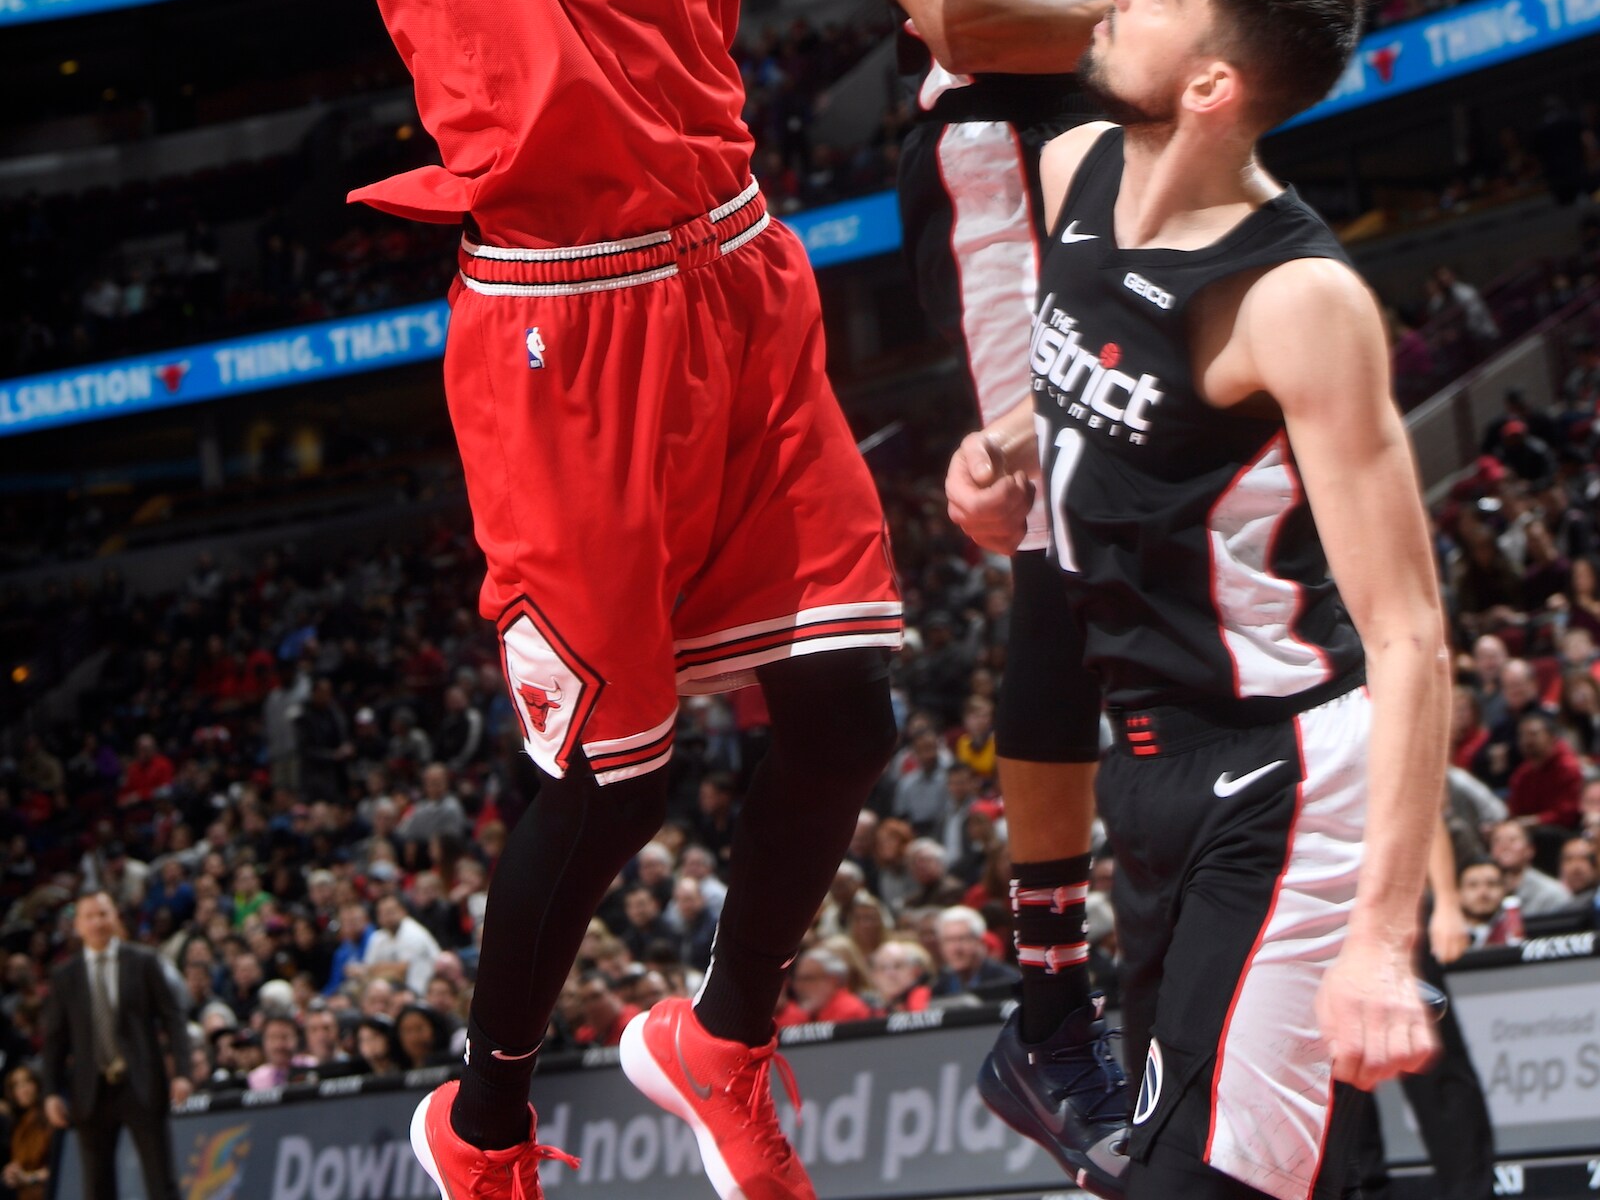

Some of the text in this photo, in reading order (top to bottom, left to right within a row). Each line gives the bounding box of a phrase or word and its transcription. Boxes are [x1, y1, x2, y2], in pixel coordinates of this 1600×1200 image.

[1123, 271, 1175, 309] GEICO
[1050, 307, 1079, 334] THE
[214, 335, 323, 384] THING.
[329, 310, 442, 364] THAT'S
[1492, 1013, 1595, 1041] Download
[1490, 1051, 1565, 1102] App
